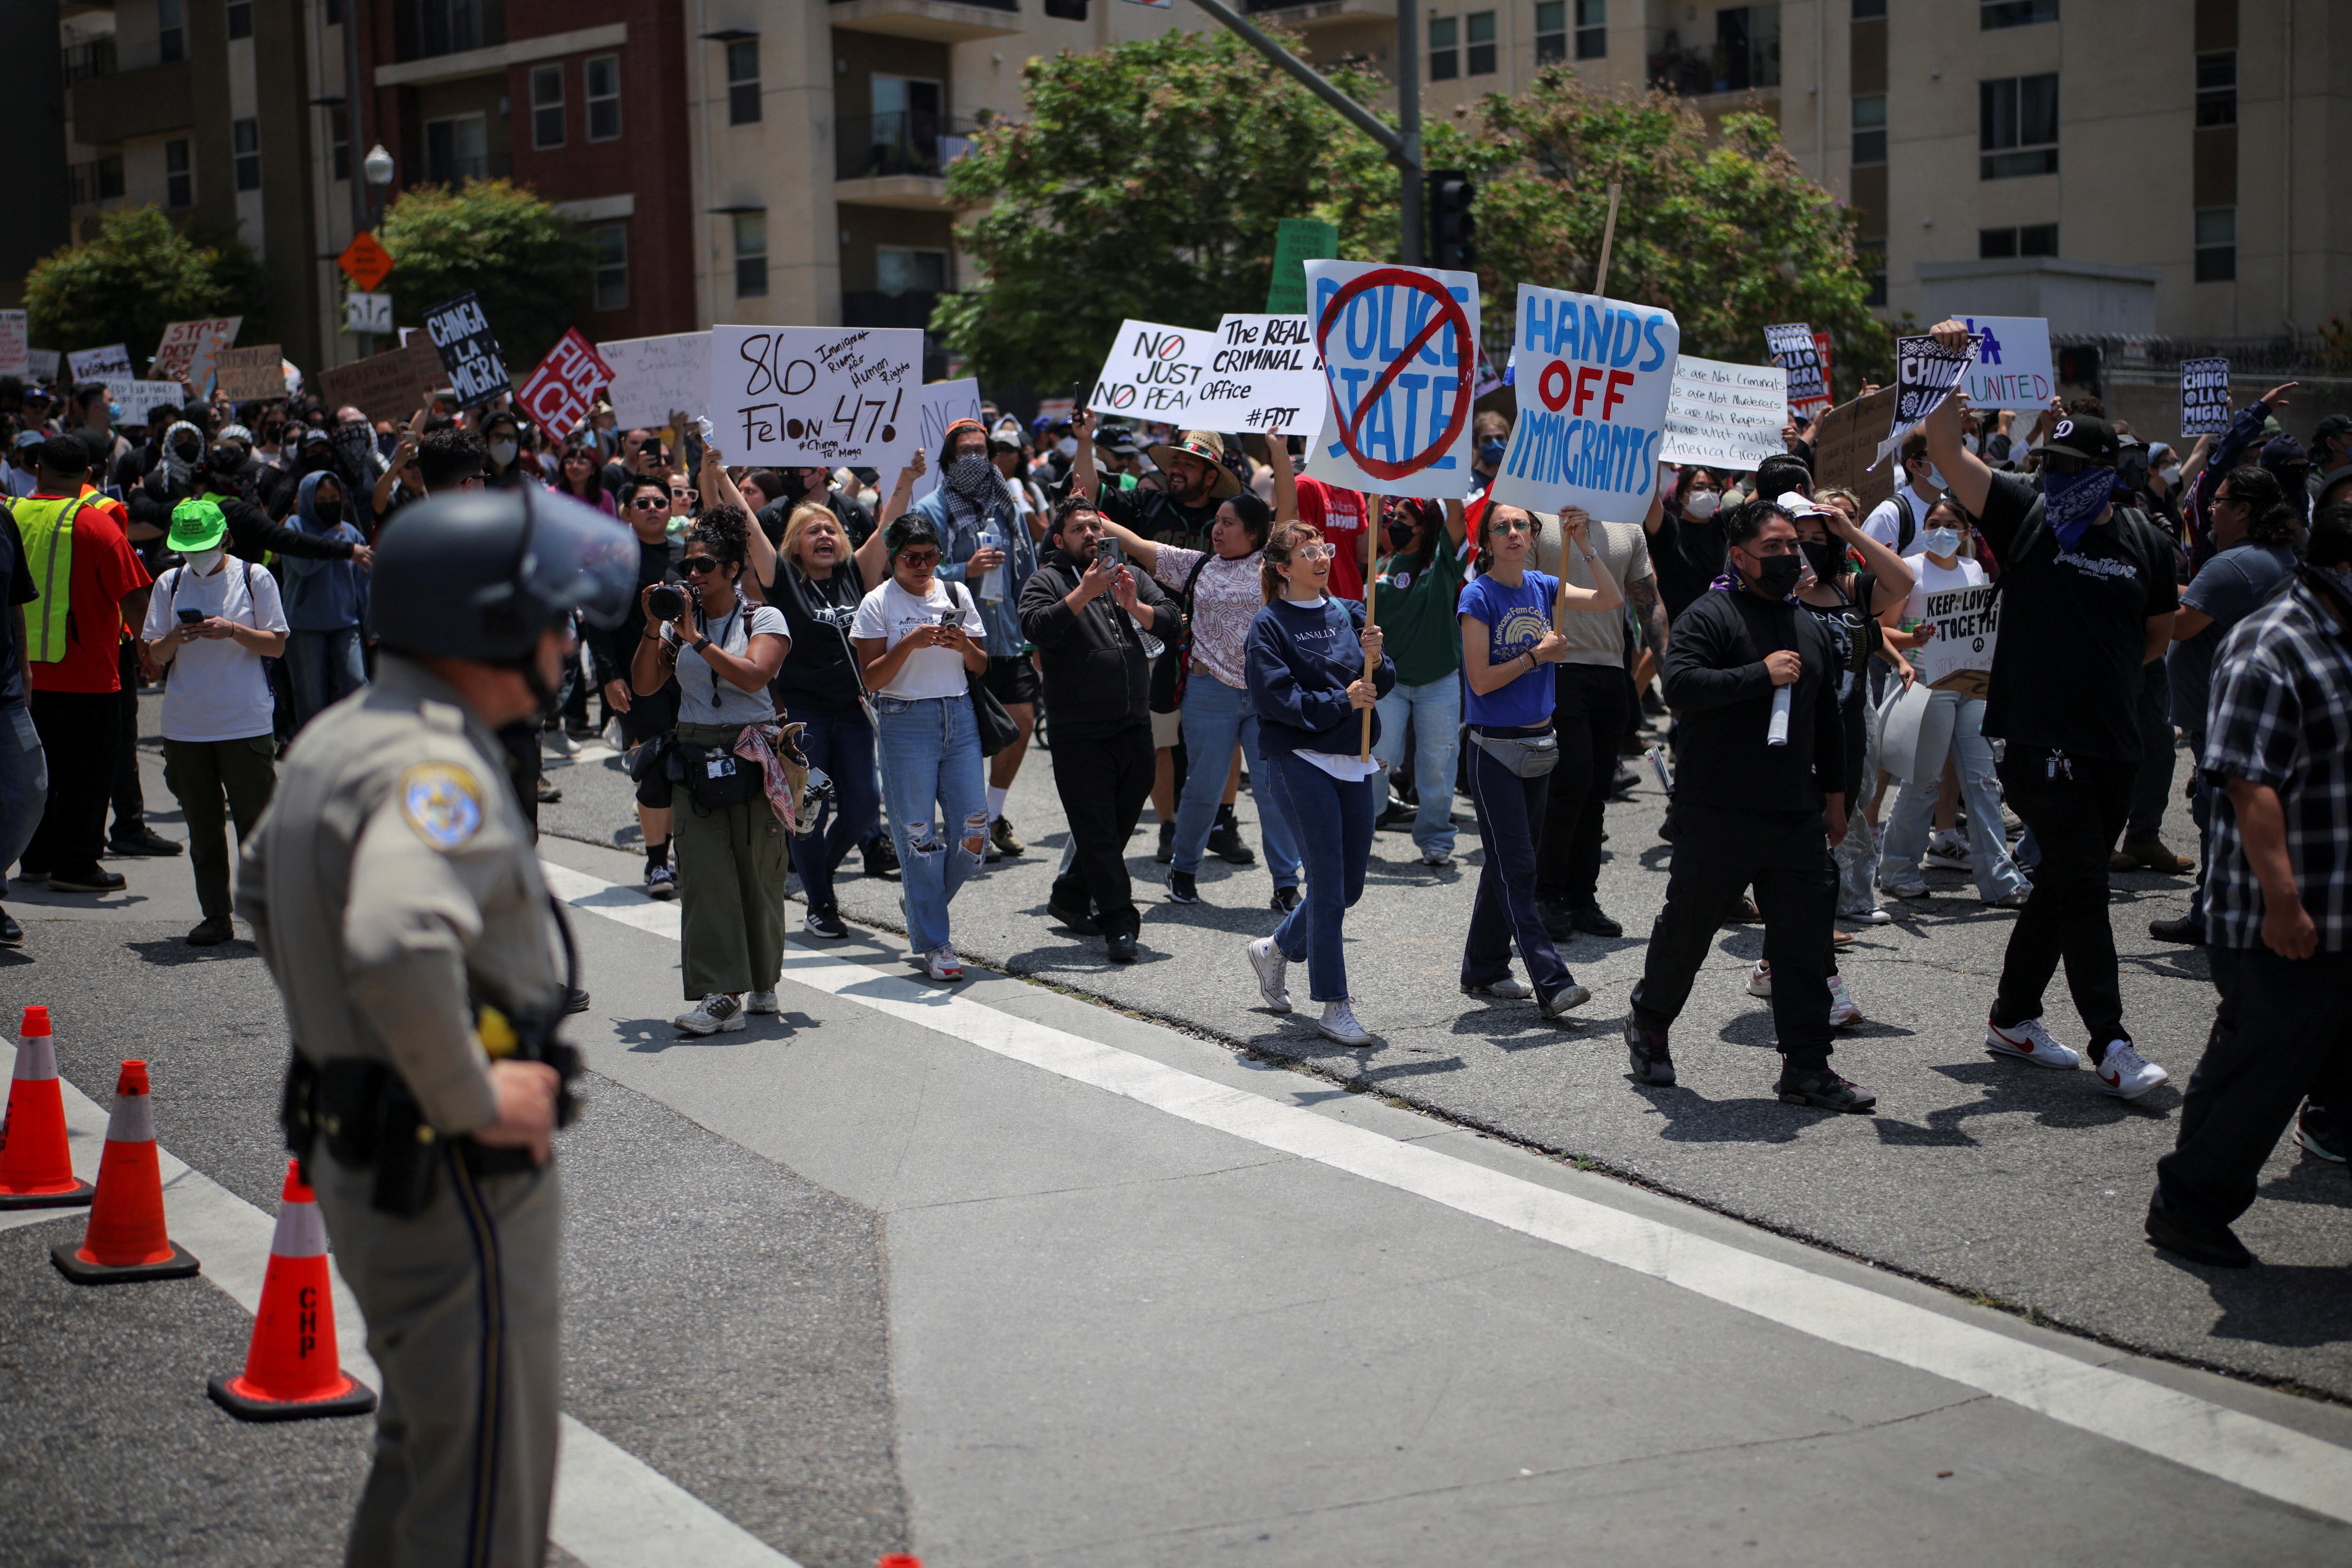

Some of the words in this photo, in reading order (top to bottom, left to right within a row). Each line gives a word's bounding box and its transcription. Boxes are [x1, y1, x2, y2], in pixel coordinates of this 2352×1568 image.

[173, 320, 228, 341] STOP
[427, 301, 489, 348] CHINGA
[1317, 277, 1469, 367] POLICE
[1225, 320, 1258, 346] The
[1262, 320, 1310, 347] REAL
[1525, 295, 1665, 372] HANDS
[454, 342, 482, 362] LA
[603, 345, 625, 358] We
[815, 330, 870, 364] Immigrant
[1771, 335, 1814, 355] CHINGA
[547, 336, 610, 404] FUCK
[741, 333, 816, 396] 86
[849, 355, 864, 372] ARE
[1213, 349, 1304, 373] CRIMINAL
[1787, 352, 1804, 368] LA
[447, 354, 510, 403] MIGRA
[879, 362, 910, 386] Rights
[1691, 370, 1707, 381] are
[1712, 371, 1731, 383] Not
[1737, 374, 1786, 391] Criminals
[1788, 366, 1821, 386] IGRA
[1902, 357, 1968, 388] CHINGA
[2183, 373, 2228, 390] CHINGA
[1144, 387, 1191, 410] PEA
[1200, 380, 1251, 402] Office
[1538, 359, 1635, 421] OFF
[1687, 390, 1705, 399] are
[1709, 392, 1727, 404] Not
[1732, 395, 1781, 409] Murderers
[1971, 375, 2048, 402] UNITED
[2199, 388, 2215, 404] LA
[520, 366, 585, 441] ICE
[2183, 405, 2228, 421] MIGRA
[1246, 408, 1300, 428] #FDT
[1327, 365, 1458, 469] STATE
[1685, 409, 1700, 419] are
[1706, 410, 1727, 423] Not
[1731, 412, 1775, 428] Rapists
[1680, 426, 1697, 435] are
[2053, 420, 2074, 439] D
[797, 439, 838, 452] #Chinga
[839, 447, 861, 460] Maga
[1506, 408, 1657, 495] IMMIGRANTS
[1663, 435, 1724, 459] America
[2078, 569, 2108, 580] WORLDWIDE
[1927, 594, 1956, 617] KEEP
[1295, 628, 1336, 641] McNALLY
[1494, 612, 1512, 645] Kaimana
[1509, 607, 1527, 616] Farm
[1935, 657, 1956, 678] STOP
[1963, 657, 1974, 670] ICE
[300, 1287, 316, 1359] CHP
